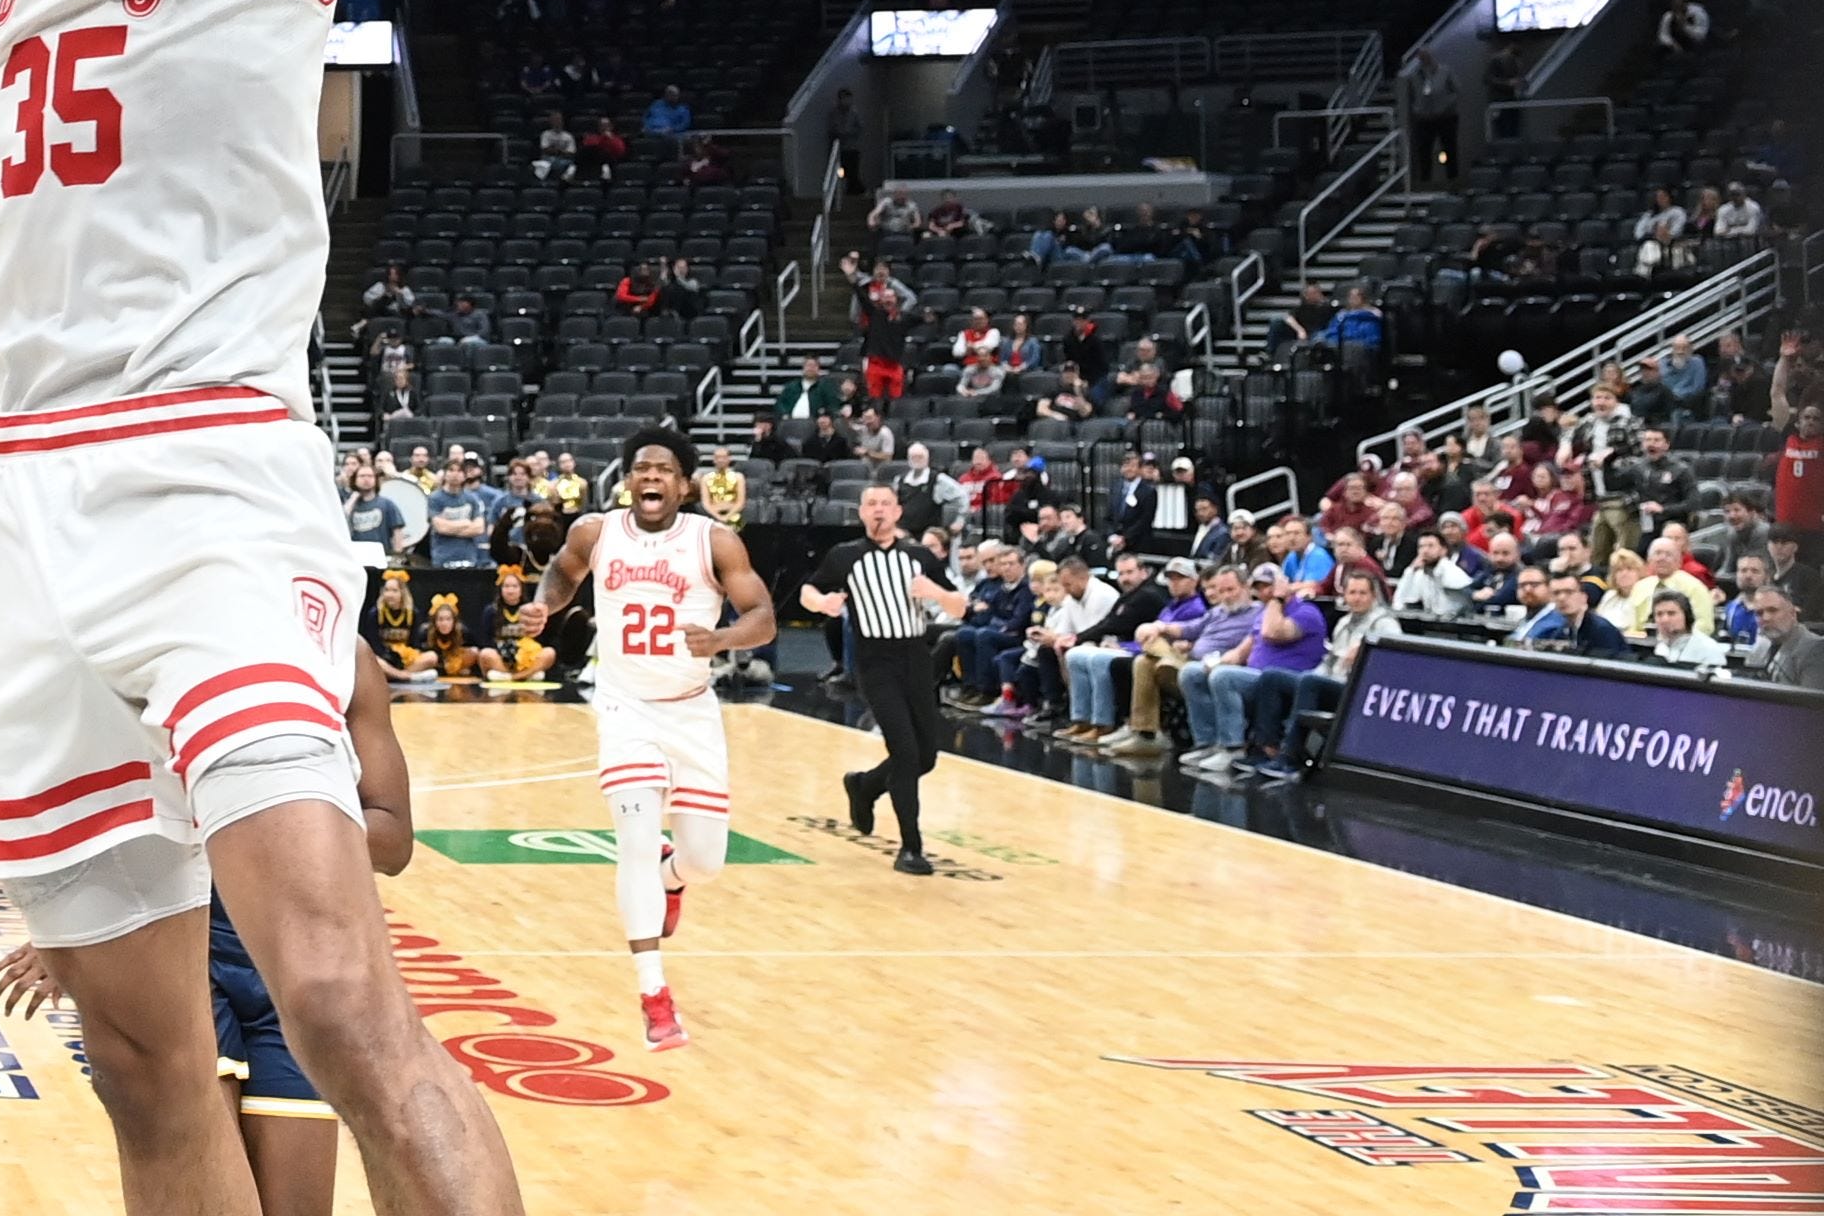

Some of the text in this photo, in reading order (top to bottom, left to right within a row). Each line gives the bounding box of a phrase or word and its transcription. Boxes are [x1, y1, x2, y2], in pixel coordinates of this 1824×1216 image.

[0, 25, 129, 199] 35
[604, 559, 691, 605] Bradley
[622, 604, 675, 656] 22
[1362, 683, 1720, 776] EVENTS THAT TRANSFORM
[1243, 1108, 1484, 1168] THE
